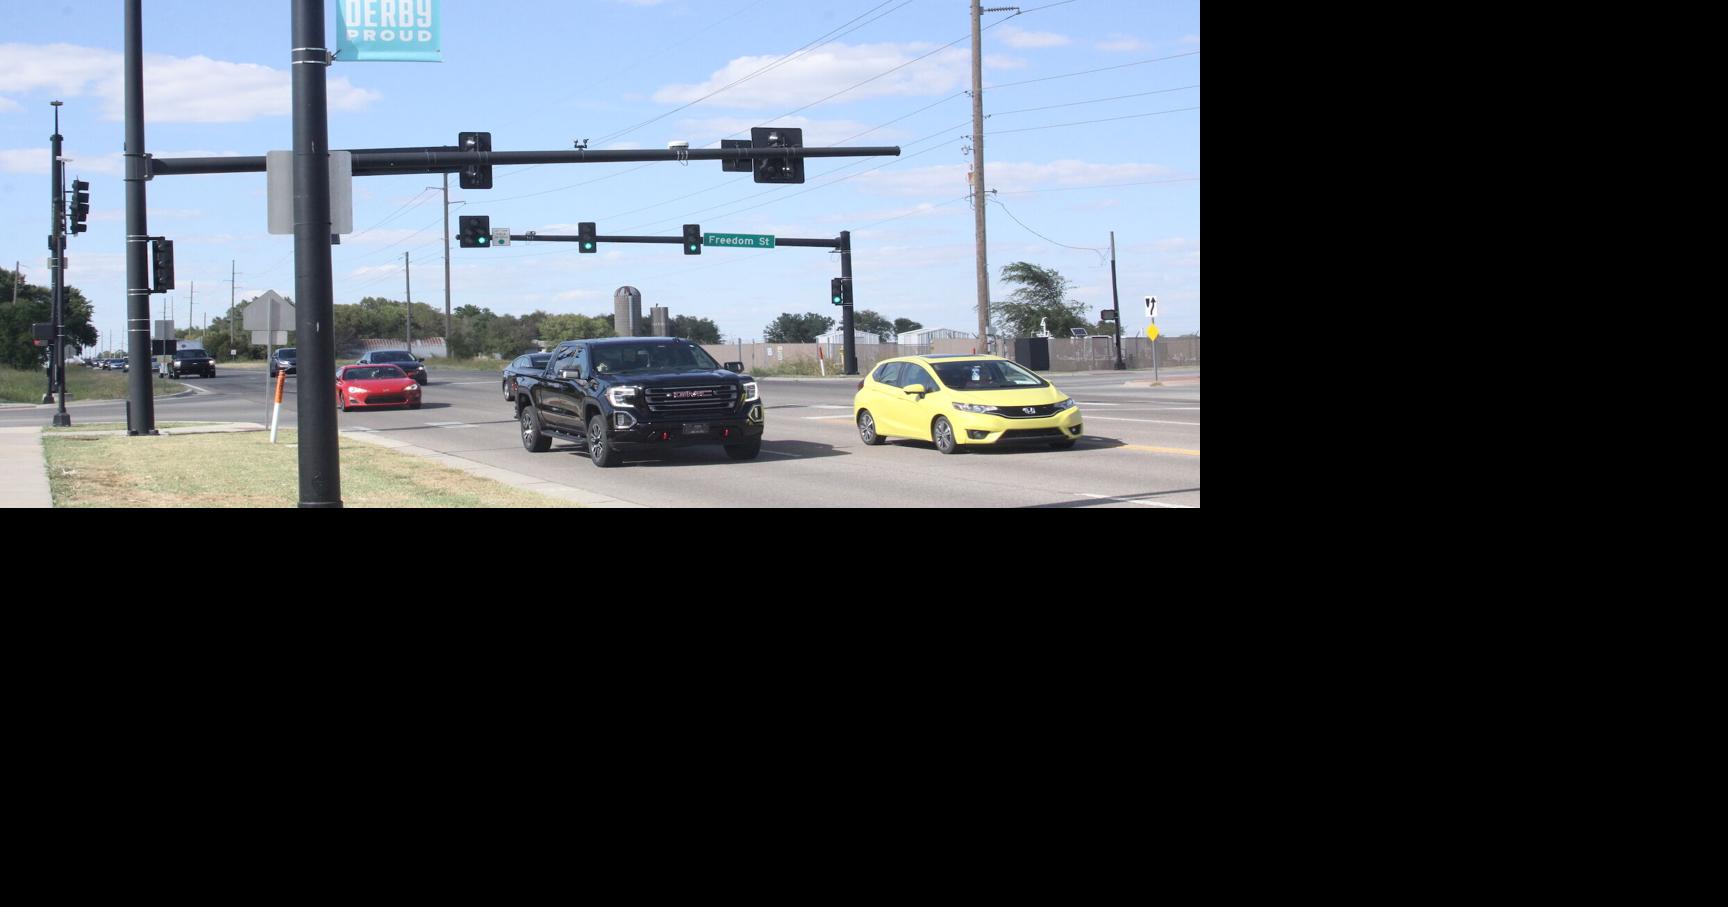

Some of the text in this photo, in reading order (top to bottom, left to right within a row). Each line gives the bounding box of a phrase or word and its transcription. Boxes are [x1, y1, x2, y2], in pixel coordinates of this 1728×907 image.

[345, 0, 432, 28] DERBY
[346, 30, 432, 42] PROUD
[708, 235, 769, 246] Freedom St
